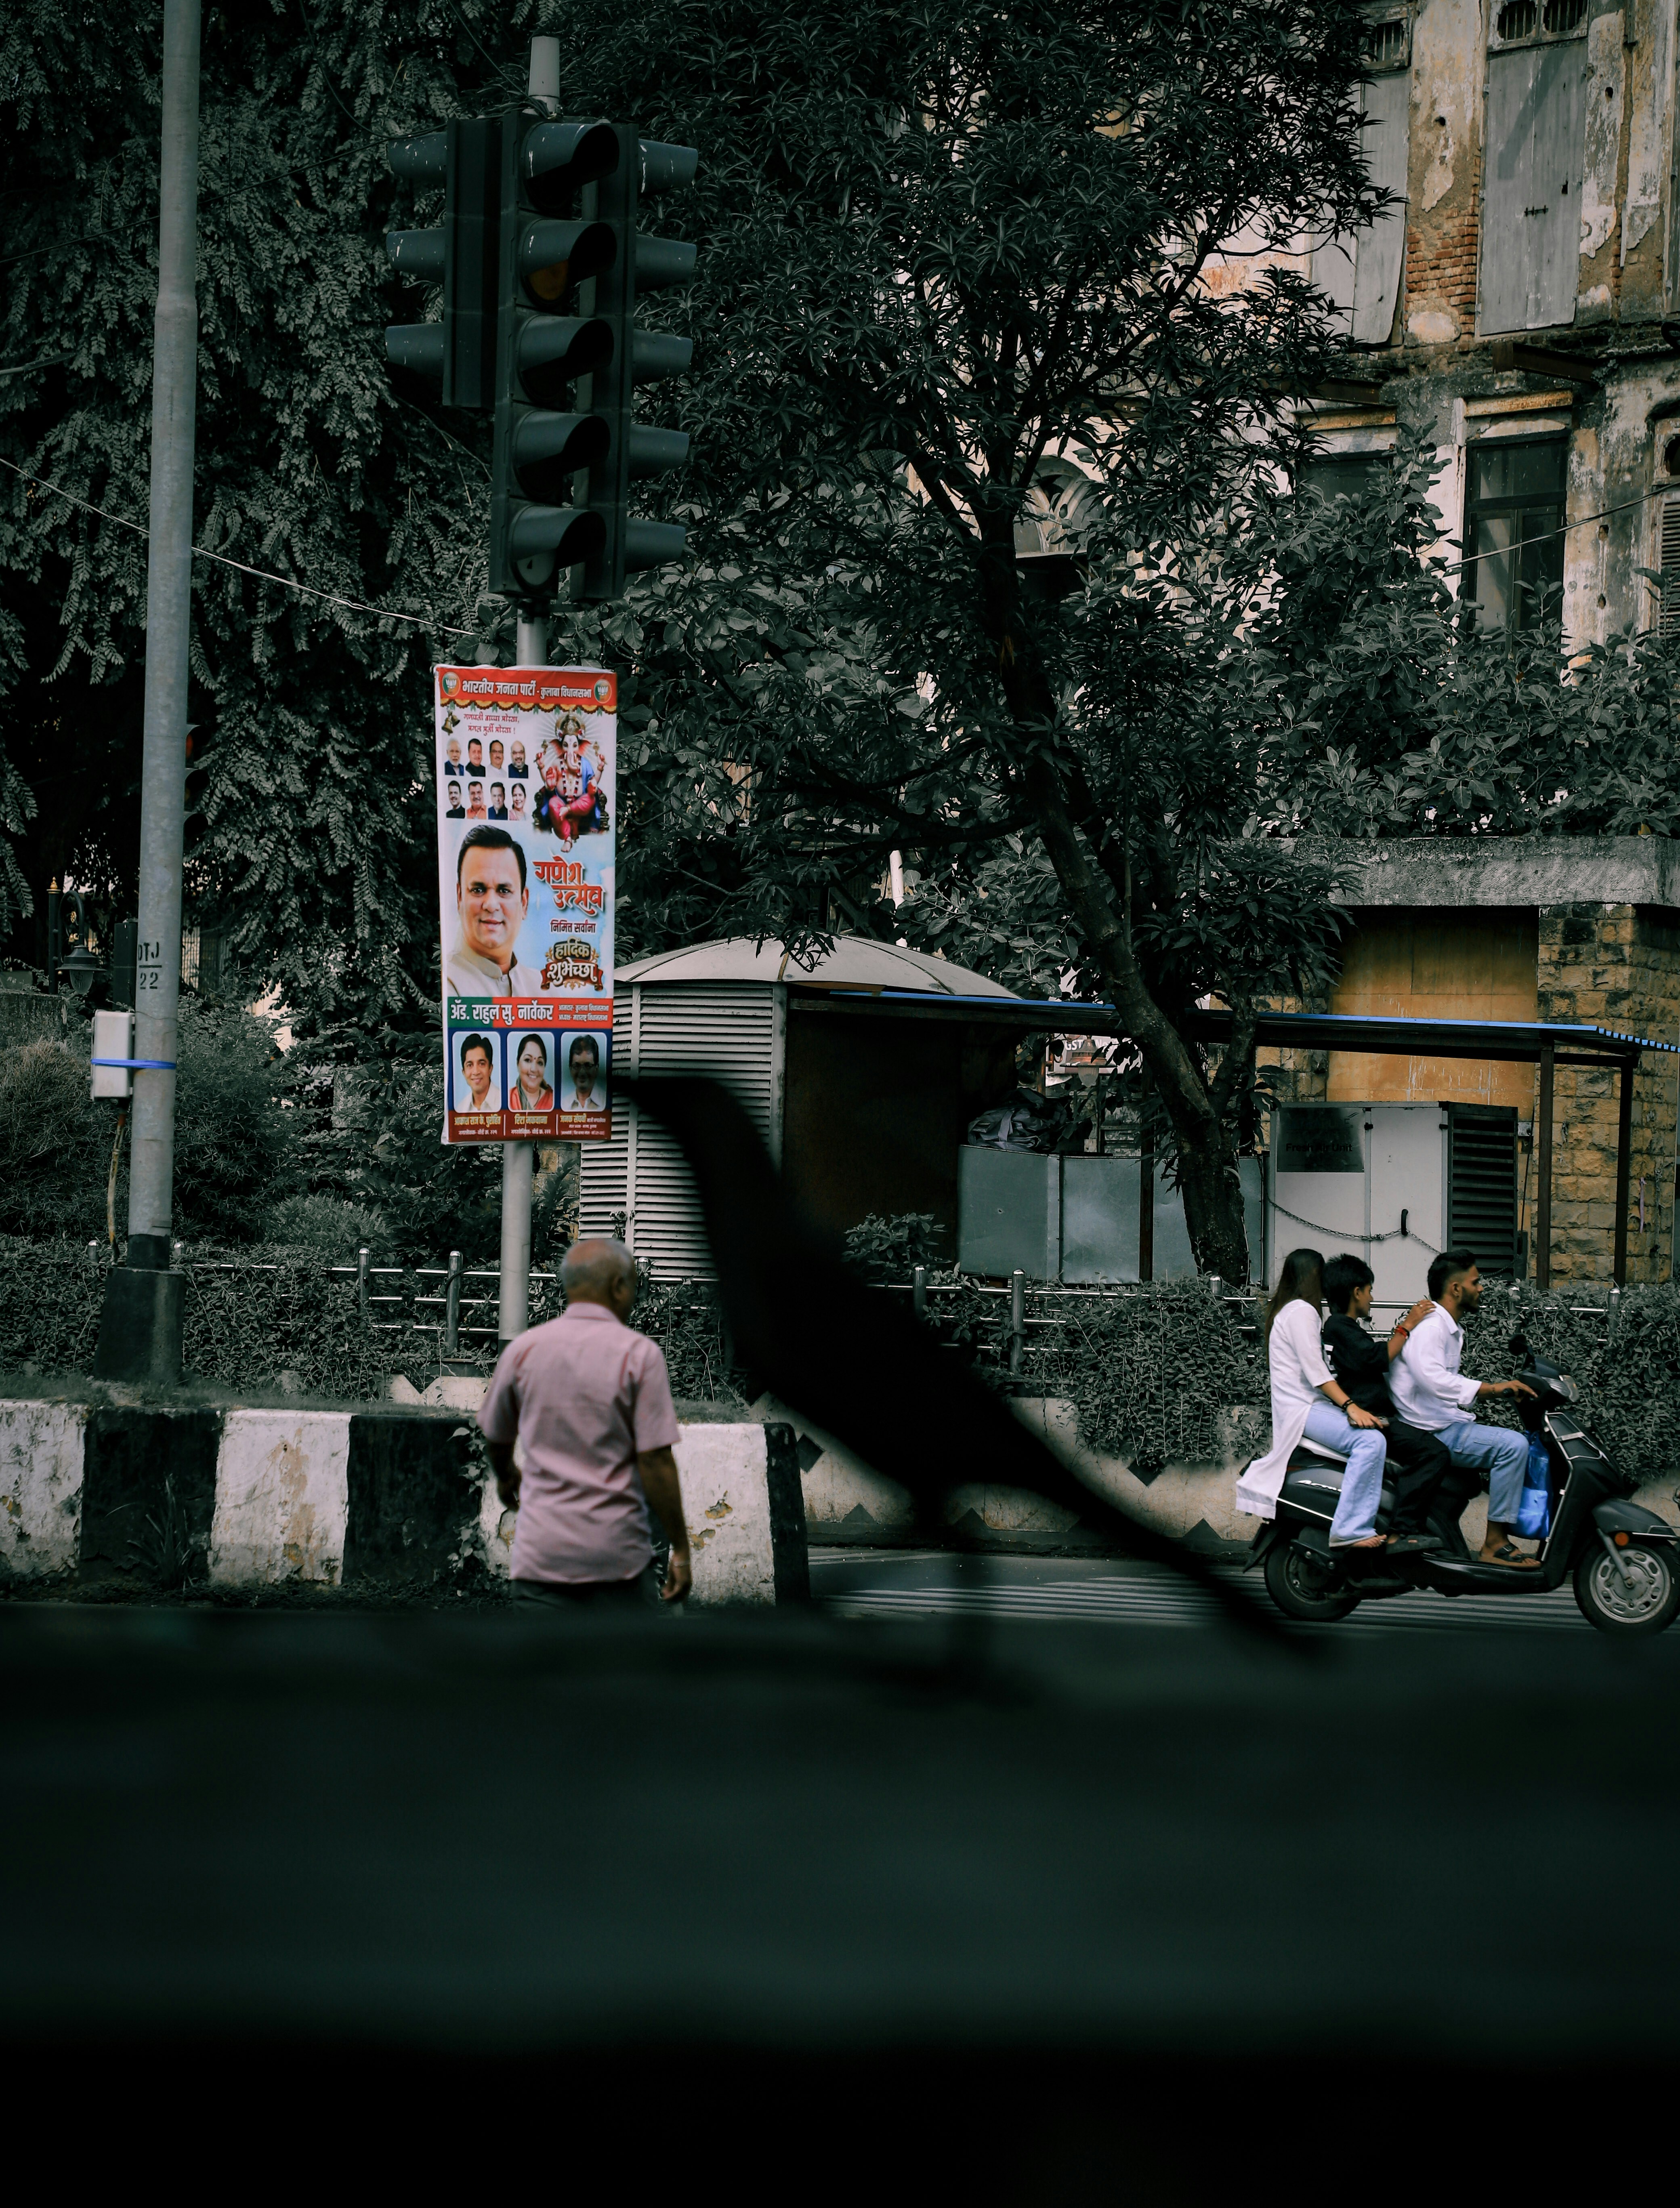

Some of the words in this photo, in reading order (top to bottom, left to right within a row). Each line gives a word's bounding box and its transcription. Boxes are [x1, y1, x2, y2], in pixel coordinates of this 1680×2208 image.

[462, 677, 495, 694] भारतीय
[495, 682, 519, 695] जनता
[519, 680, 536, 696] पार्टी
[540, 687, 560, 700] कुलाबा
[561, 685, 592, 698] विधानसभा
[464, 711, 483, 721] गणपती
[532, 855, 584, 885] गणेश
[551, 882, 604, 916] उत्सव
[550, 920, 573, 933] निमित्त
[555, 936, 590, 959] हार्दिक
[140, 972, 158, 990] 22
[547, 957, 598, 984] शुभेच्छा
[471, 1004, 500, 1025] राहुल
[500, 1004, 515, 1026] सु.
[517, 1000, 554, 1021] नार्वेकर
[1065, 1039, 1084, 1050] GST
[1286, 1143, 1312, 1151] Fresh
[1332, 1143, 1353, 1151] Unit
